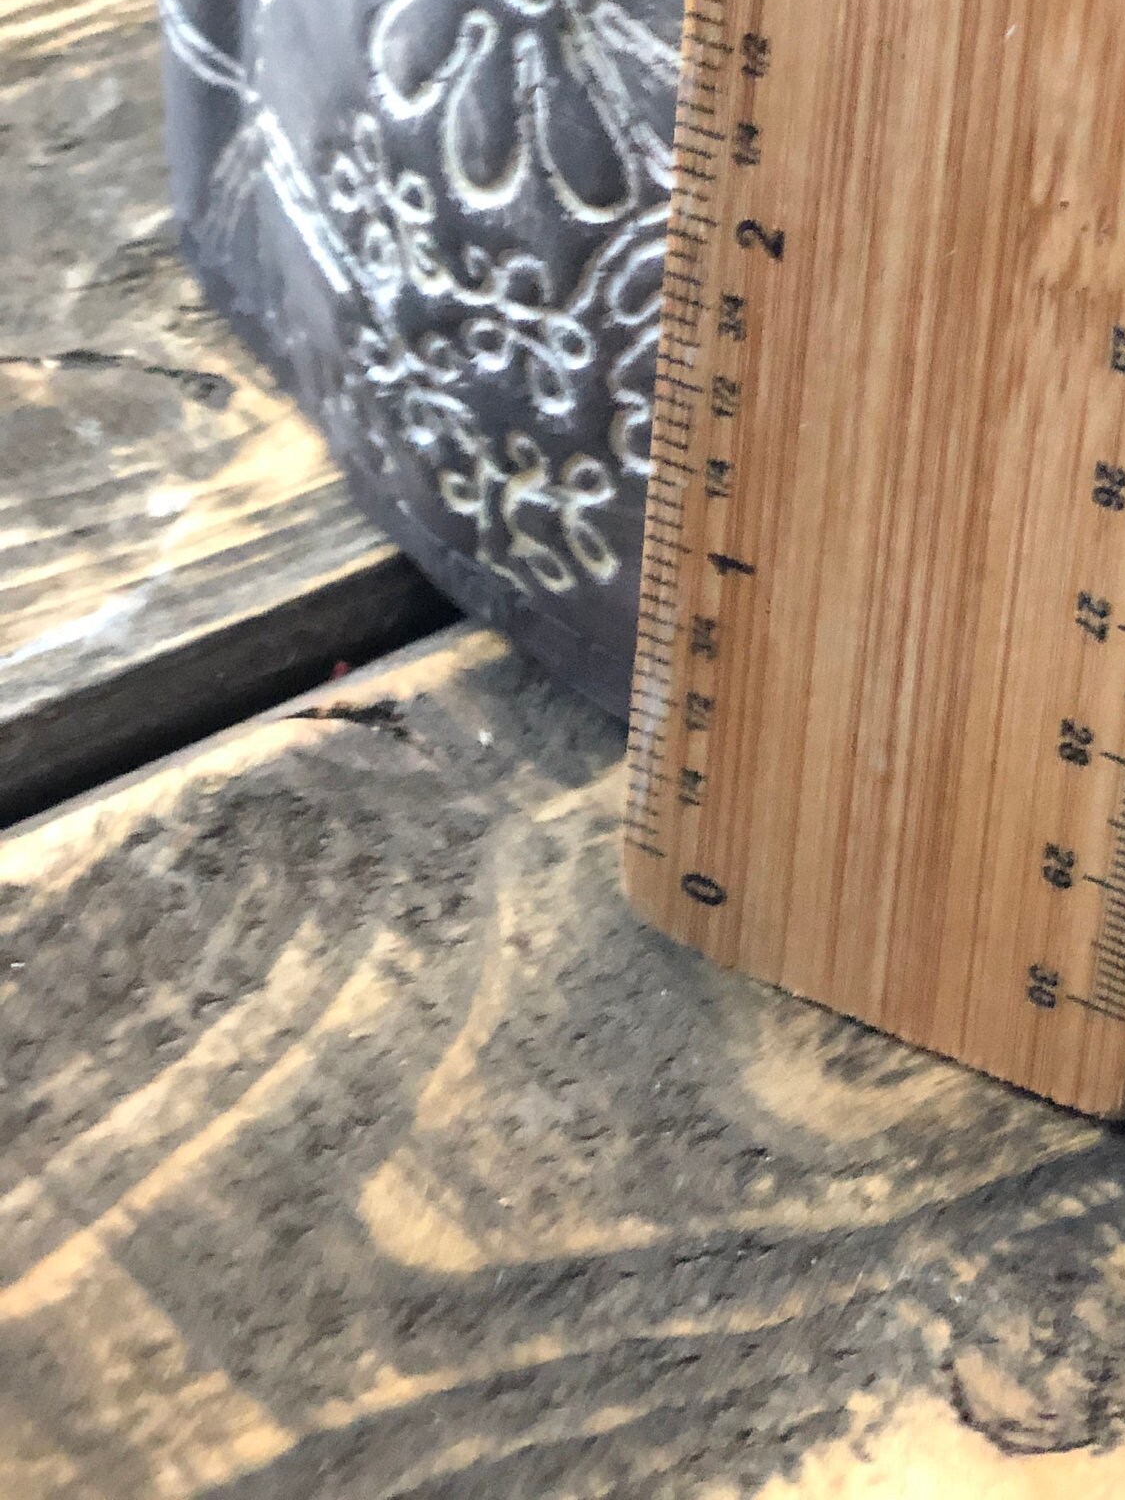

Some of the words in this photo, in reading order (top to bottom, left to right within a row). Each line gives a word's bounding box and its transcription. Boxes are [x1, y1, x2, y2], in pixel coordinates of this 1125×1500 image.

[736, 219, 785, 262] 2
[707, 552, 756, 576] 1
[1075, 591, 1111, 642] 27
[1058, 718, 1094, 766] 28
[1042, 842, 1076, 890] 29
[680, 872, 728, 906] 0
[1027, 964, 1060, 1008] 30
